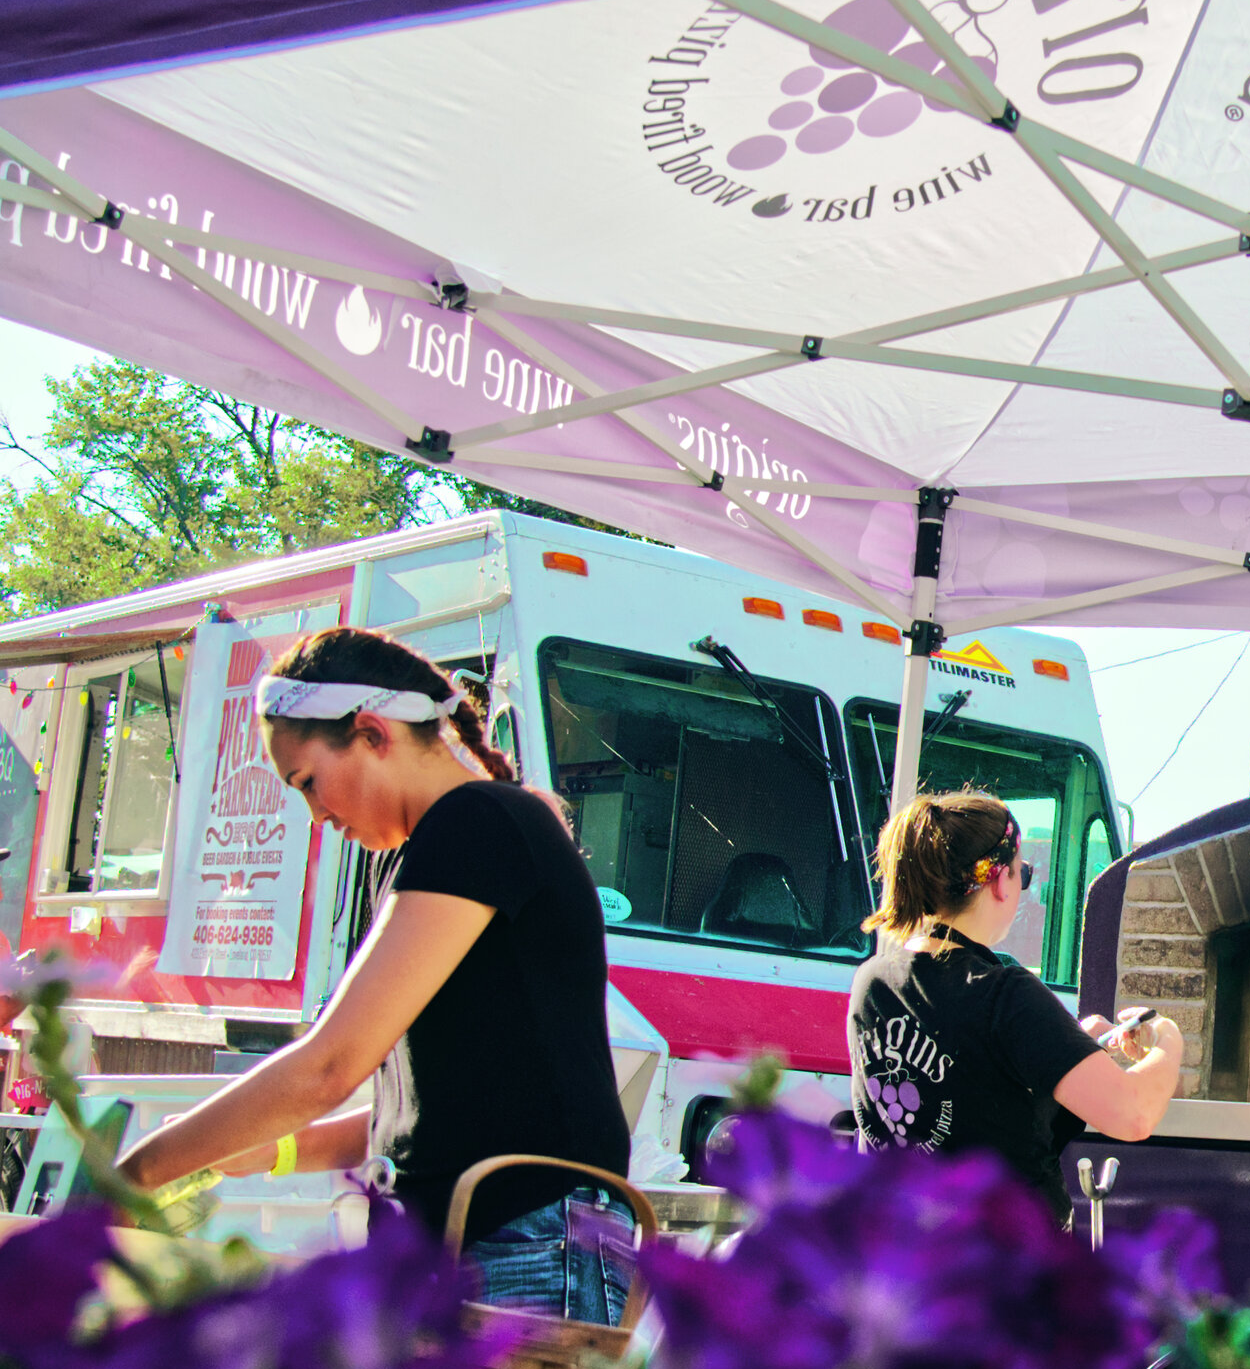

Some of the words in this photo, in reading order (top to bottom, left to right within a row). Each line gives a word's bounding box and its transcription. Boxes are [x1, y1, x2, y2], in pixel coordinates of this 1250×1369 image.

[928, 658, 1017, 690] TILIMASTER
[217, 766, 282, 818] FARMSTEAD
[193, 925, 274, 946] 406-624-9386
[857, 1014, 954, 1083] rigins
